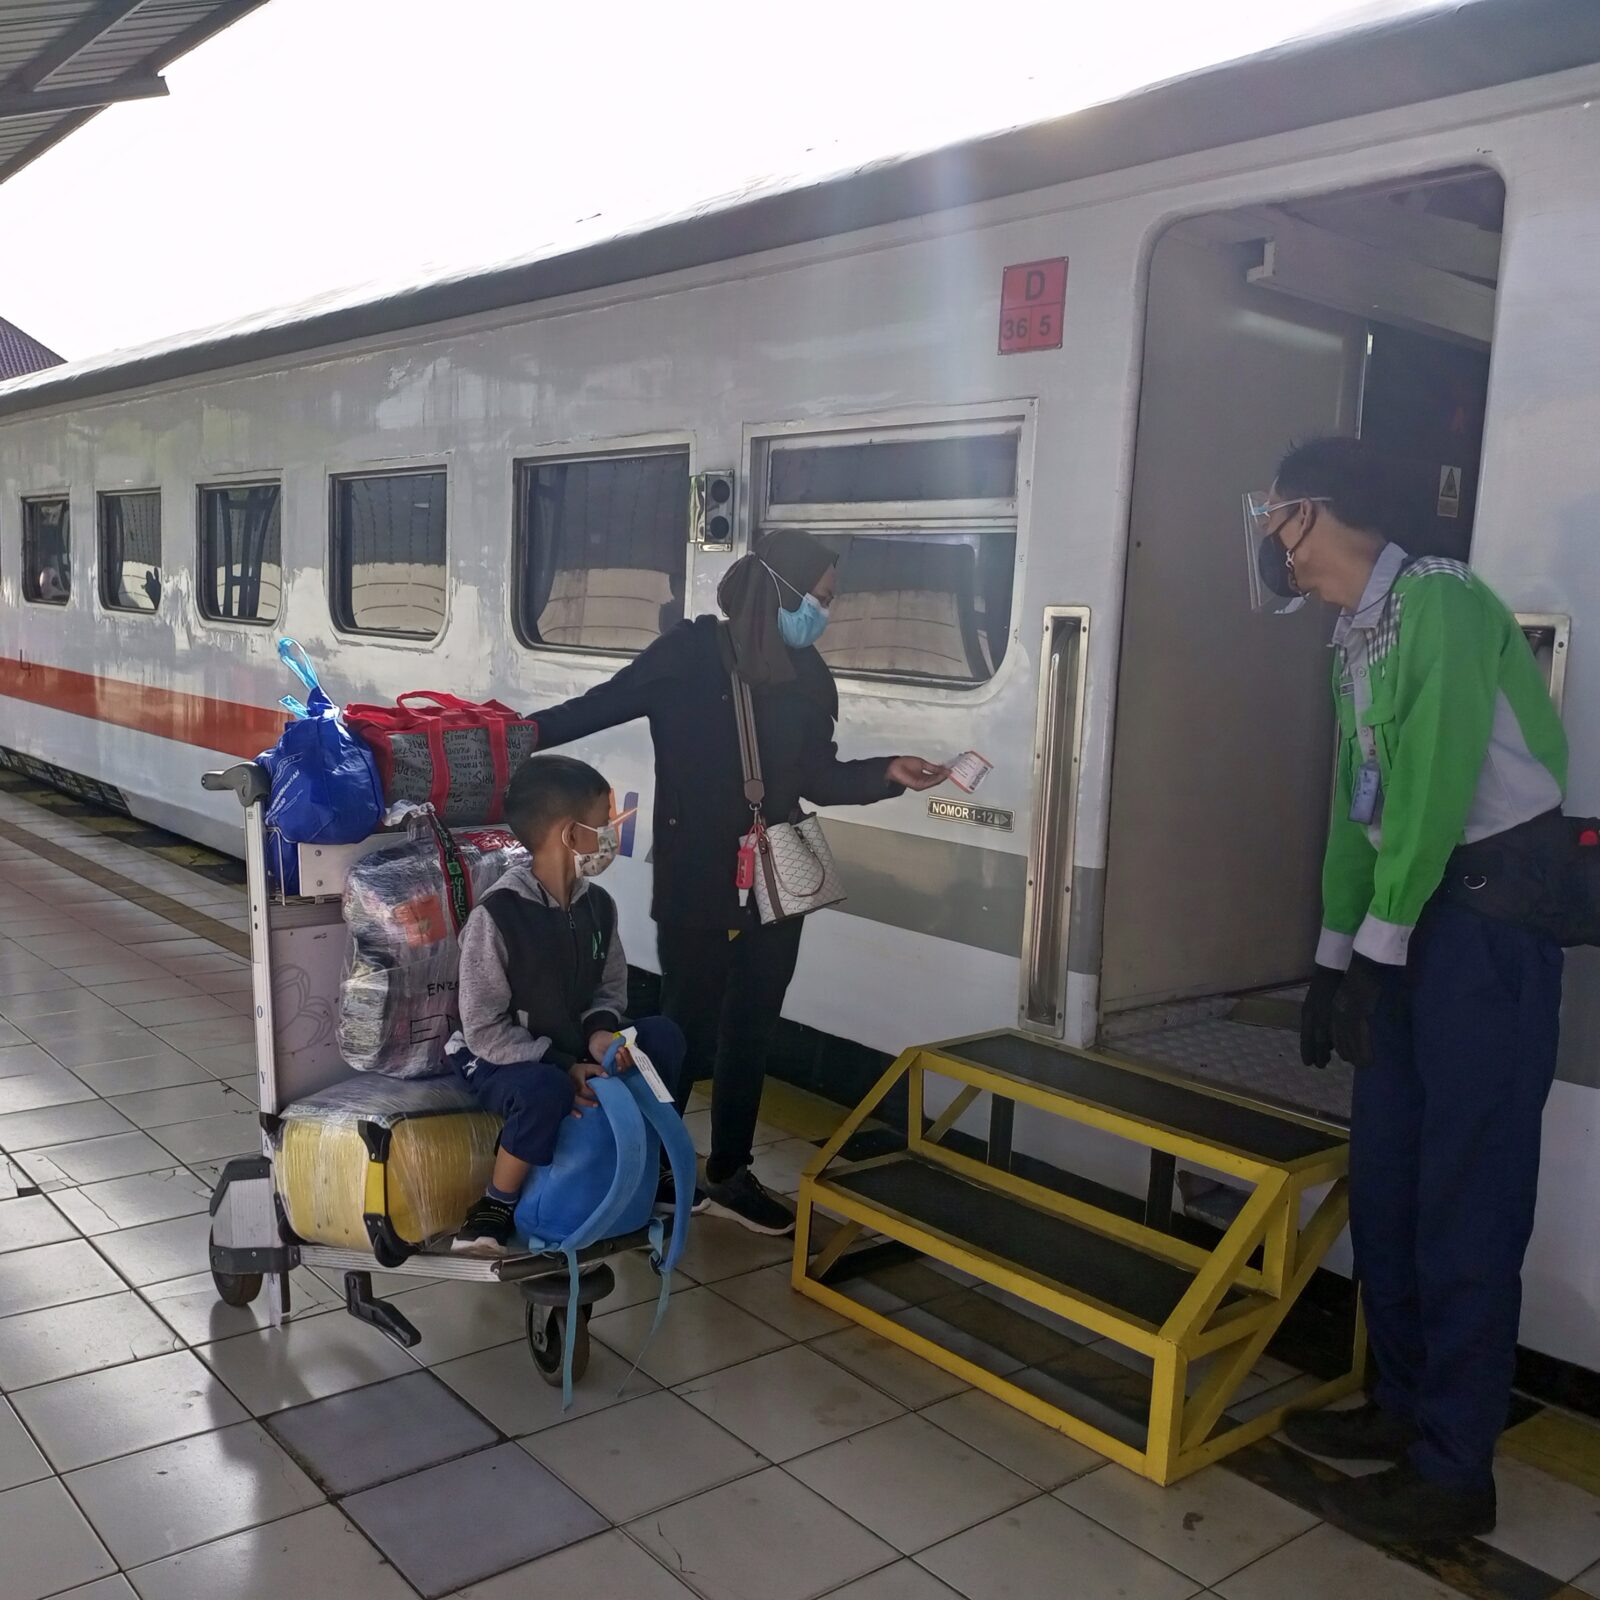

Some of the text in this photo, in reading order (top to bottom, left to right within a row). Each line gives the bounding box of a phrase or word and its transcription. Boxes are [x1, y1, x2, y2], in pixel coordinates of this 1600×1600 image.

[1025, 270, 1046, 302] D
[1003, 314, 1051, 341] 36 5
[932, 802, 969, 819] NOMOR
